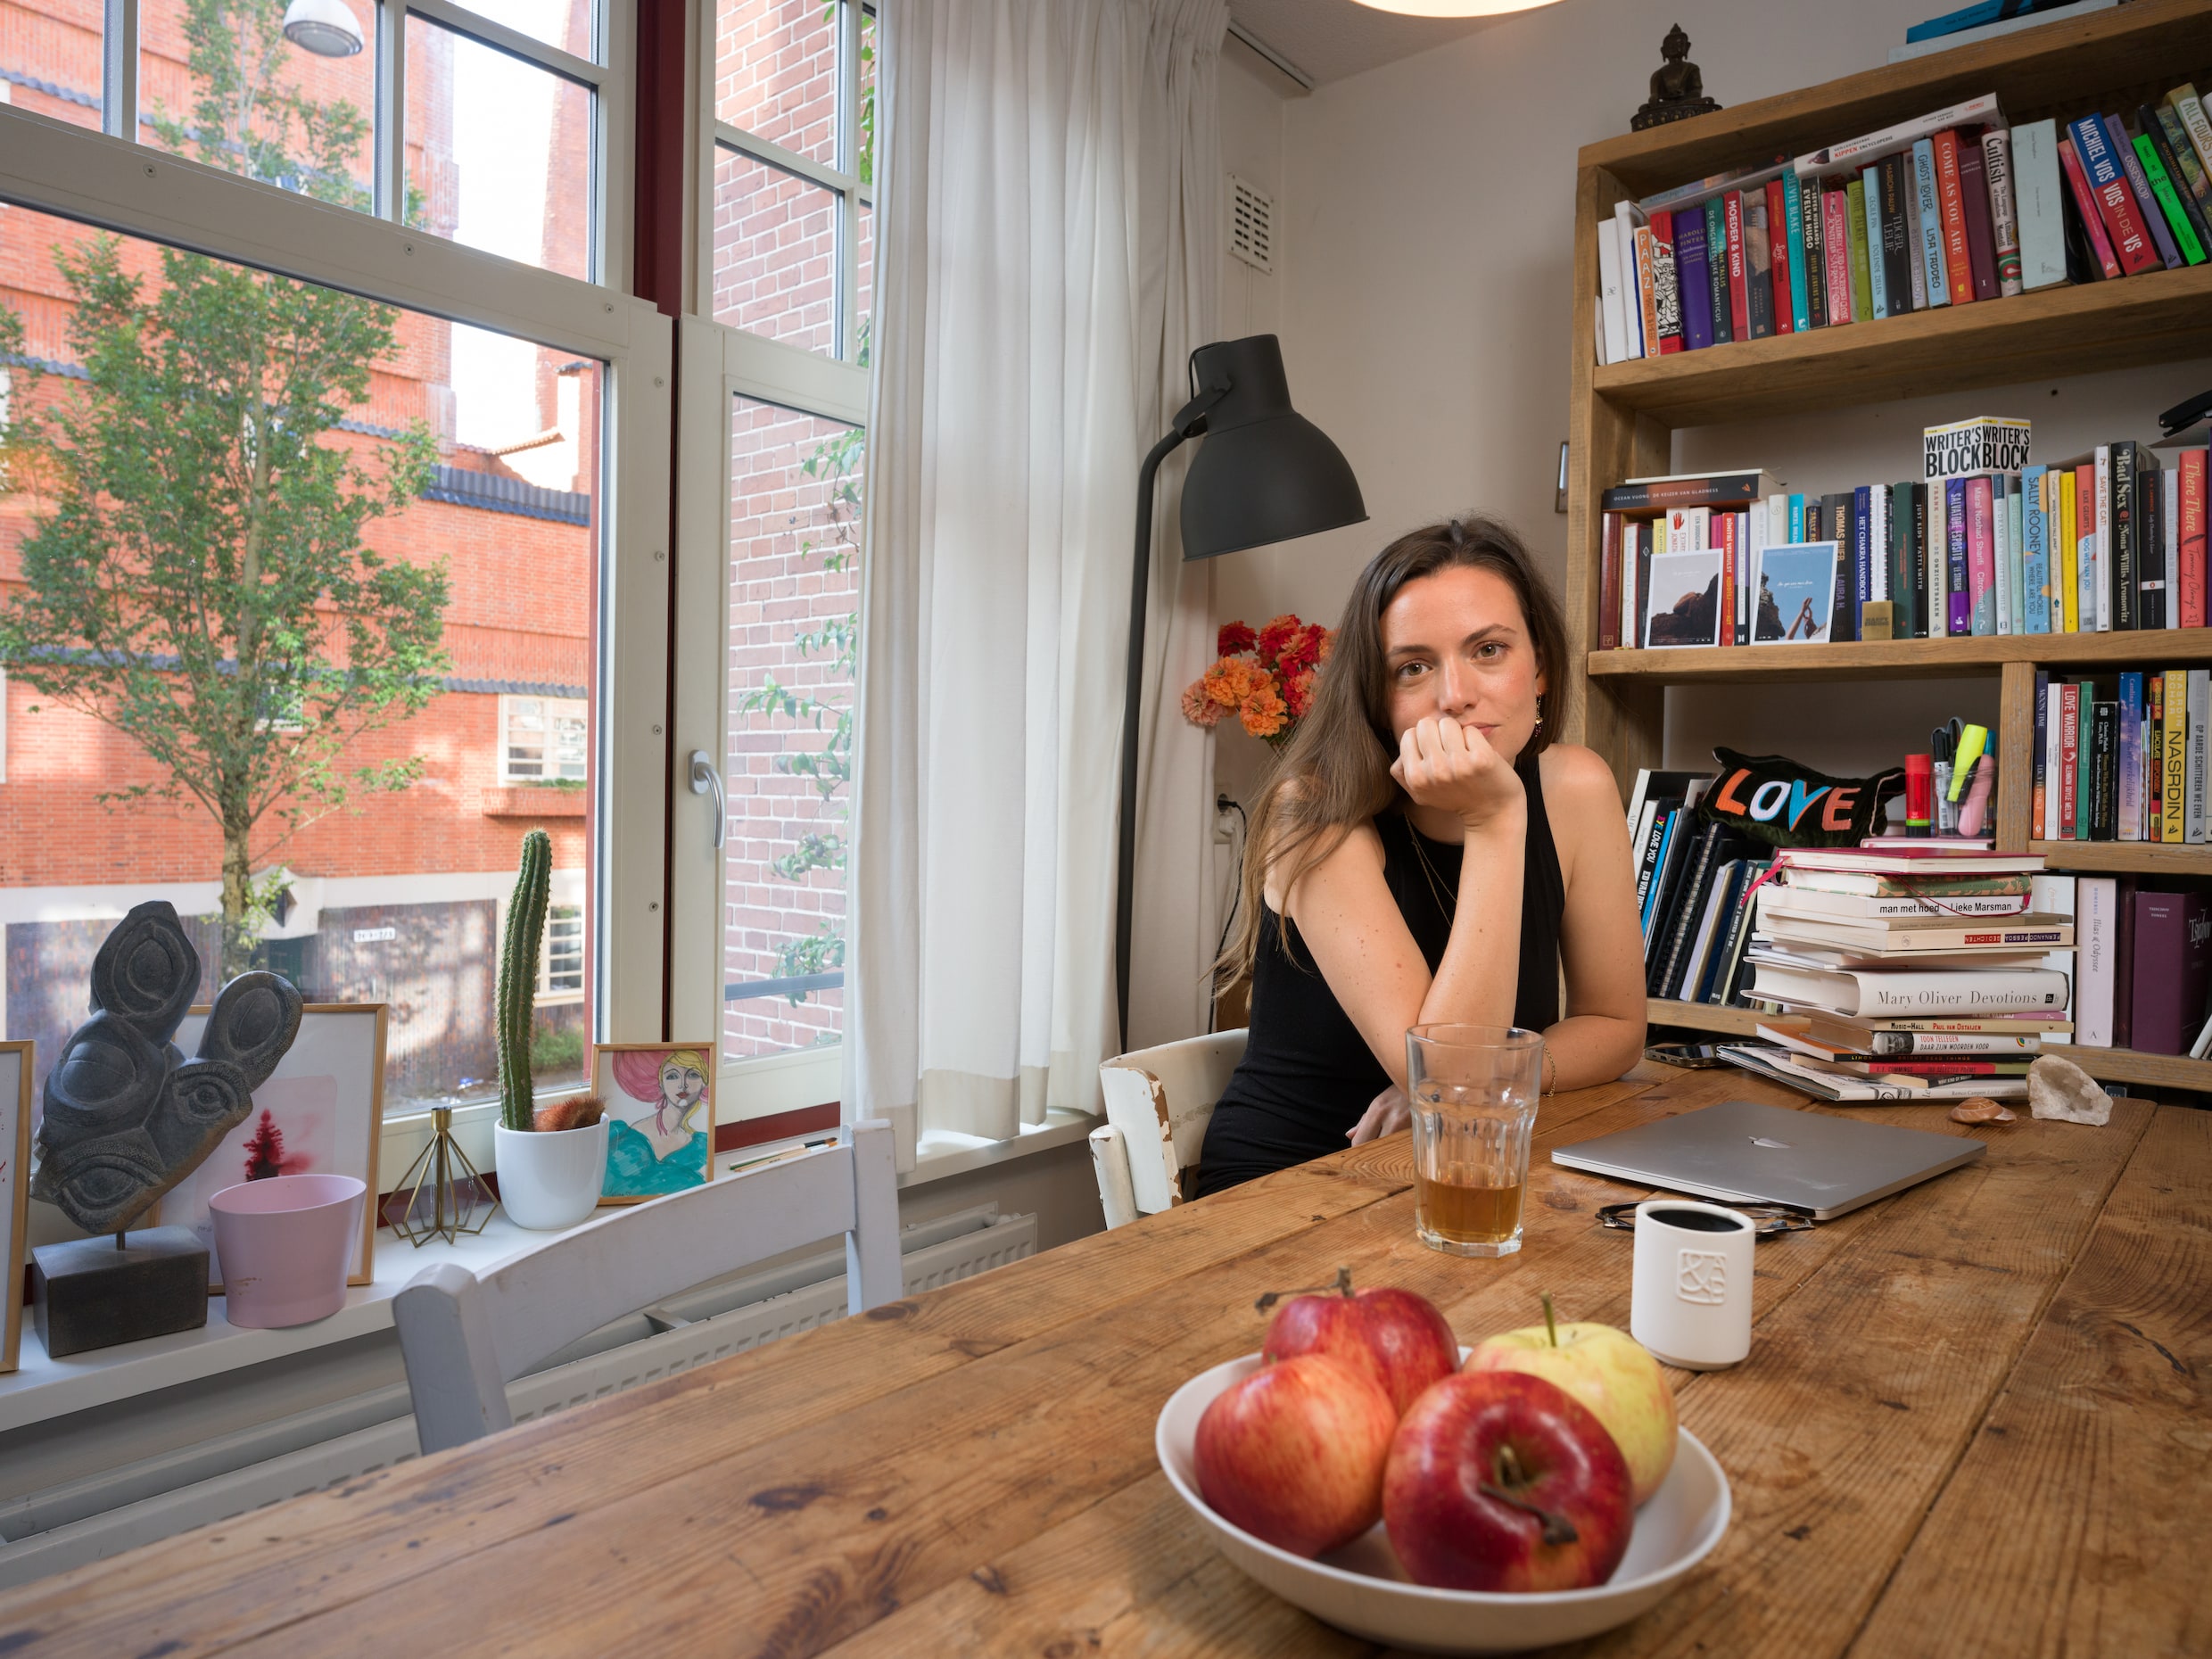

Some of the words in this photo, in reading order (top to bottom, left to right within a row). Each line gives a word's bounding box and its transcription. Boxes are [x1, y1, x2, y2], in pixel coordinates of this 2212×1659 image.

[2183, 102, 2200, 120] ALL
[2191, 120, 2212, 152] FOURS
[1834, 146, 1858, 159] KIPPEN
[1942, 143, 1954, 177] COME
[1985, 137, 2006, 186] Cultish
[2077, 118, 2105, 161] MICHIEL
[2093, 159, 2116, 183] VOS
[1886, 164, 1894, 192] MARION
[1919, 154, 1930, 181] GHOST
[2125, 154, 2150, 200] OSSENKOP
[1787, 173, 1797, 203] OLIVIE
[1920, 184, 1934, 212] LOVER
[1945, 181, 1956, 196] AS
[2103, 183, 2125, 207] VOS
[1708, 210, 1714, 219] DE
[1803, 189, 1812, 221] EVELYN
[1887, 194, 1895, 213] PAUW
[1948, 200, 1960, 225] YOU
[2113, 205, 2125, 219] IN
[1728, 200, 1738, 243] MOEDER
[1789, 205, 1800, 235] BLAKE
[2004, 220, 2013, 246] Amanda
[2118, 219, 2133, 236] DE
[1679, 227, 1705, 240] HAROLD
[1680, 235, 1704, 247] PINTER
[1805, 223, 1814, 249] HUGO
[1827, 215, 1836, 254] JONATHAN
[1911, 228, 1920, 262] HUNGER
[1926, 228, 1937, 249] LISA
[1951, 229, 1962, 255] ARE
[1997, 224, 2006, 247] Montell
[2123, 235, 2142, 252] VS
[1709, 221, 1719, 275] ONGENEESLIJKE
[1717, 241, 1725, 263] FRANK
[1872, 244, 1880, 273] DOLENDE
[1639, 234, 1652, 289] PAAZ
[1732, 252, 1741, 276] KIND
[1834, 214, 1844, 246] EXTREMELY
[1840, 301, 1849, 319] CLOSE
[1929, 251, 1941, 288] TADDEO
[1914, 267, 1924, 301] MOTHER
[1713, 276, 1722, 322] ROMANTICUS
[1926, 426, 1982, 452] WRITER'S
[1982, 425, 2030, 445] WRITER'S
[1926, 442, 1982, 478] BLOCK
[1983, 442, 2029, 471] BLOCK
[2116, 449, 2131, 483] Bad
[2028, 476, 2041, 506] SALLY
[2185, 461, 2200, 496] There
[1974, 487, 1983, 508] Maral
[2117, 484, 2131, 509] Sex
[1836, 505, 1845, 539] THOMAS
[1951, 492, 1961, 528] SALVATORE
[2185, 498, 2201, 532] There
[1975, 511, 1984, 539] Noshad
[2028, 509, 2041, 555] ROONEY
[2118, 524, 2129, 550] Nona
[1934, 546, 1939, 556] DE
[1951, 531, 1962, 561] ESPOSITO
[1976, 541, 1984, 565] Sharifi
[2119, 550, 2130, 578] Willis
[2183, 547, 2200, 578] Tommy
[1836, 574, 1845, 600] LAURA
[2183, 582, 2200, 610] Orange
[1836, 602, 1845, 610] H.
[2120, 579, 2130, 623] Aronowitz
[2064, 690, 2076, 711] LOVE
[2064, 713, 2076, 748] WARRIOR
[2127, 719, 2136, 733] Een
[2195, 724, 2203, 733] OP
[2195, 735, 2203, 755] AARDE
[2065, 764, 2073, 785] GLENNON
[2124, 761, 2134, 807] werkelijkheid
[2167, 730, 2182, 820] NASRDIN
[2194, 755, 2203, 792] SCHITTEREN
[1714, 768, 1861, 832] LOVE
[2064, 786, 2072, 801] DOYLE
[2194, 793, 2202, 802] WE
[1655, 814, 1666, 830] EYE
[2064, 803, 2072, 820] MELTON
[2194, 804, 2202, 819] EVEN
[1650, 830, 1662, 848] LOVE
[1647, 848, 1658, 863] YOU
[1638, 880, 1649, 896] VAN
[1641, 871, 1651, 880] ED
[1879, 905, 1898, 913] man
[1900, 903, 1917, 913] met
[1919, 902, 1940, 913] hoed
[1951, 902, 1972, 912] Lieke
[1975, 902, 2012, 912] Marsman
[2092, 918, 2101, 935] Ilias
[2090, 944, 2101, 973] Odyssee
[1878, 992, 1913, 1009] Mary
[1919, 991, 1962, 1004] Oliver
[1970, 990, 2037, 1004] Devotions
